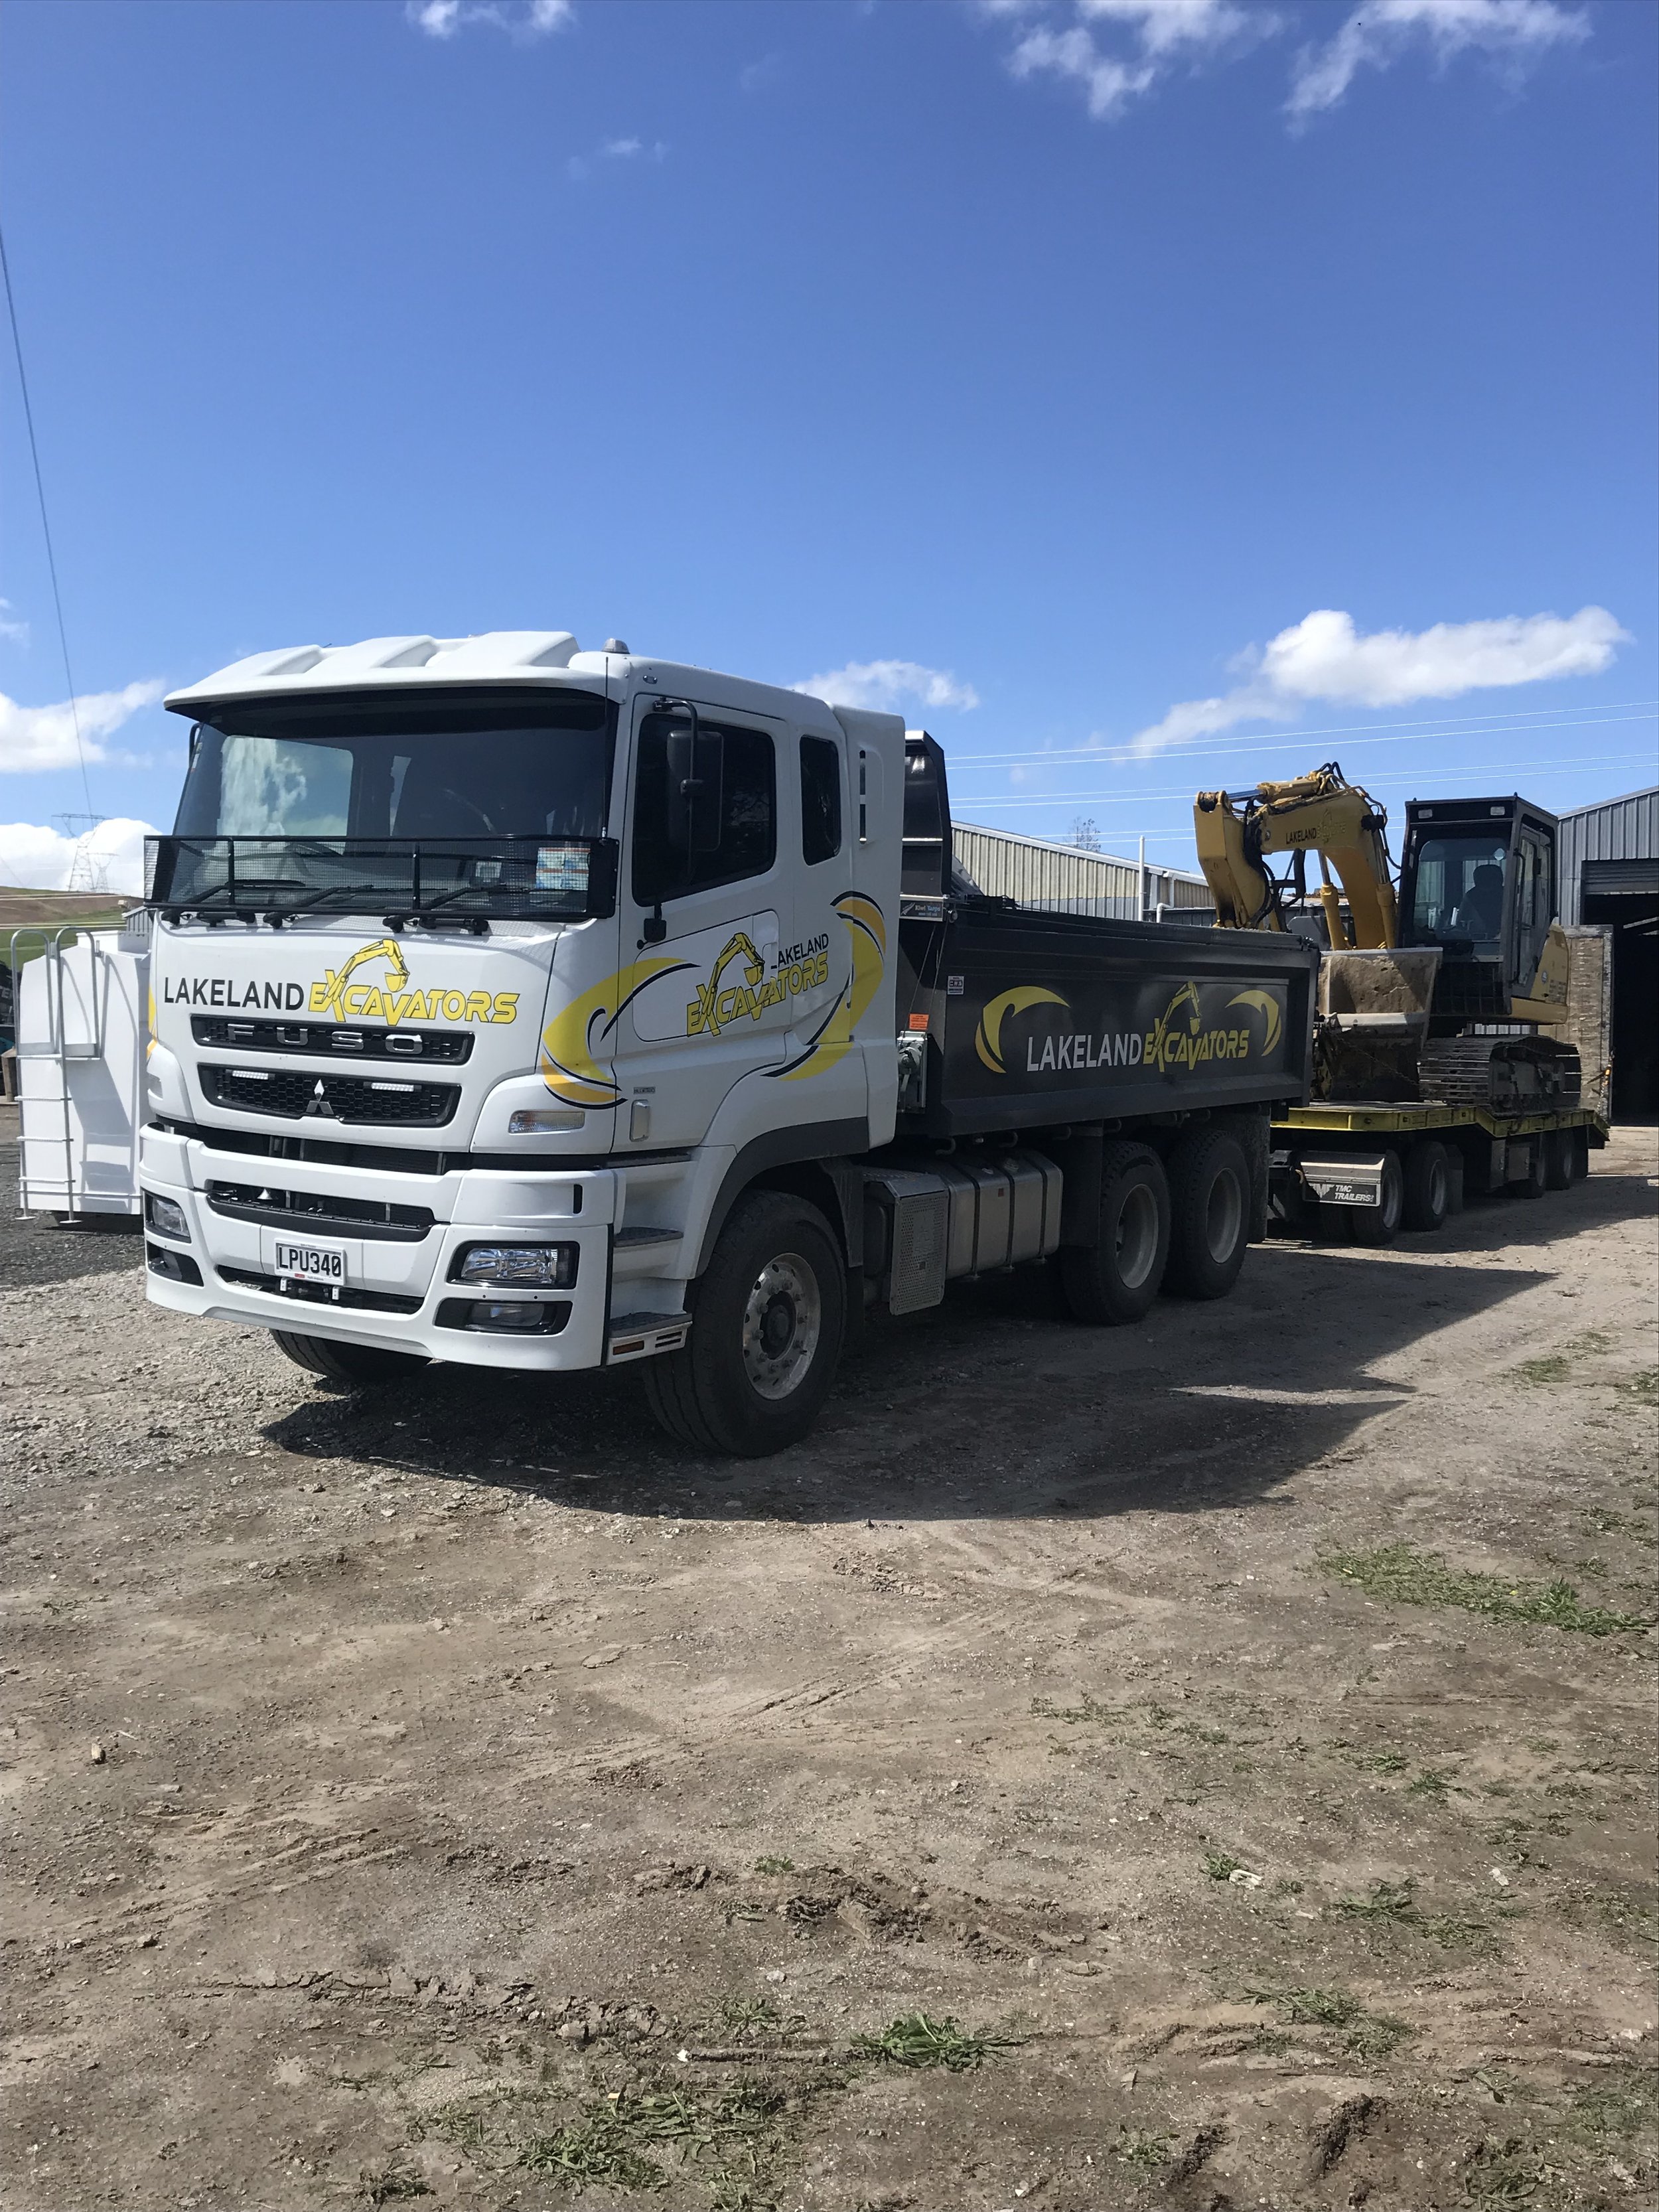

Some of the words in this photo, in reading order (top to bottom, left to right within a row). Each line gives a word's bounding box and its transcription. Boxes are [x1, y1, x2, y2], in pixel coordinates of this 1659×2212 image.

[1285, 828, 1317, 845] LAKELAND
[164, 976, 304, 1011] LAKELAND
[308, 969, 521, 1027] EXCAVATORS
[686, 951, 828, 1037] EXCAVATORS
[226, 1023, 424, 1055] FUSO
[1027, 1033, 1142, 1072] LAKELAND
[1143, 1017, 1250, 1072] EXCAVATORS
[1334, 1193, 1371, 1202] TRAILERS
[278, 1246, 342, 1277] LPU340
